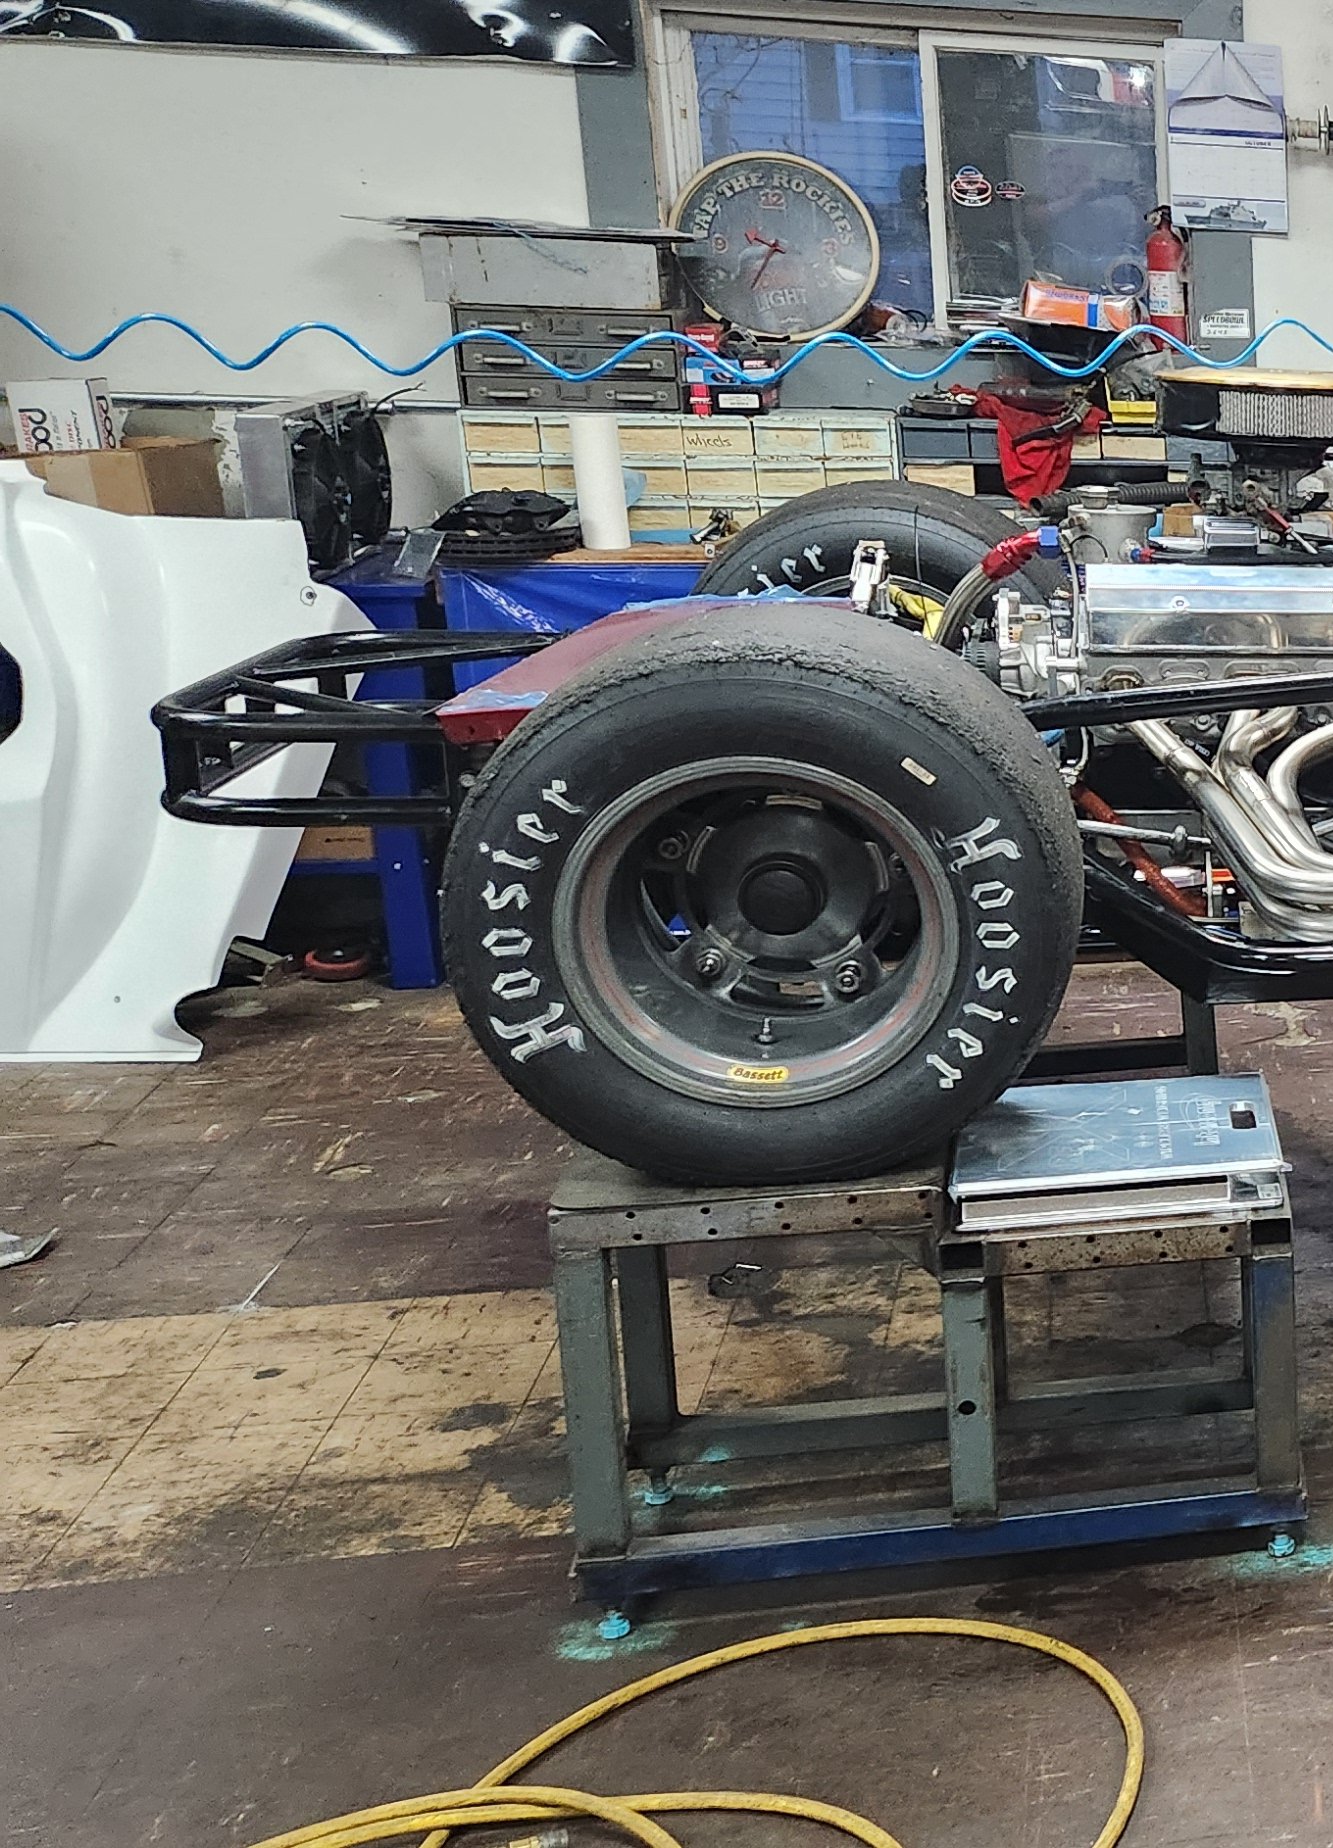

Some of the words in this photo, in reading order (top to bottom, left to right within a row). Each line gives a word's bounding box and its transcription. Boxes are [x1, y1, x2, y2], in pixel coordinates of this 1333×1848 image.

[716, 172, 766, 198] THE
[772, 171, 854, 246] ROCKIES
[754, 287, 808, 313] LIGHT
[480, 778, 587, 1065] Hoosier
[926, 816, 1024, 1092] Hoosier
[733, 1067, 784, 1081] Bassett
